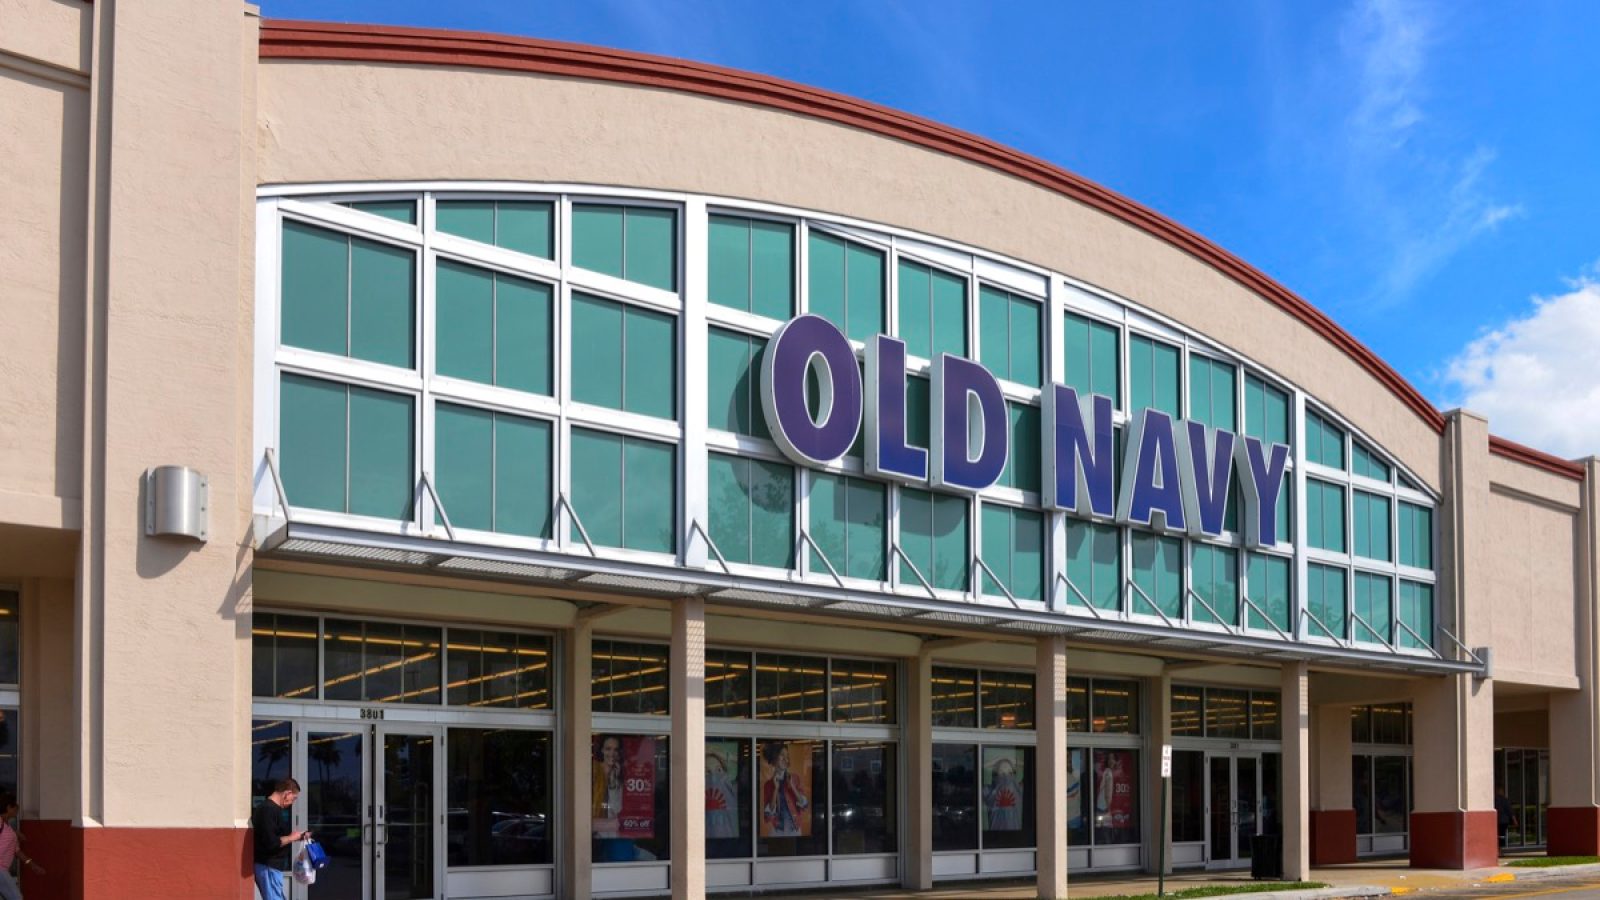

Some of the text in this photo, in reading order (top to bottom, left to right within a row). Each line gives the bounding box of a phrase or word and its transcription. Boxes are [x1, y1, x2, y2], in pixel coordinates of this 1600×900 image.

[763, 313, 1290, 547] OLD NAVY
[360, 708, 384, 720] 3801
